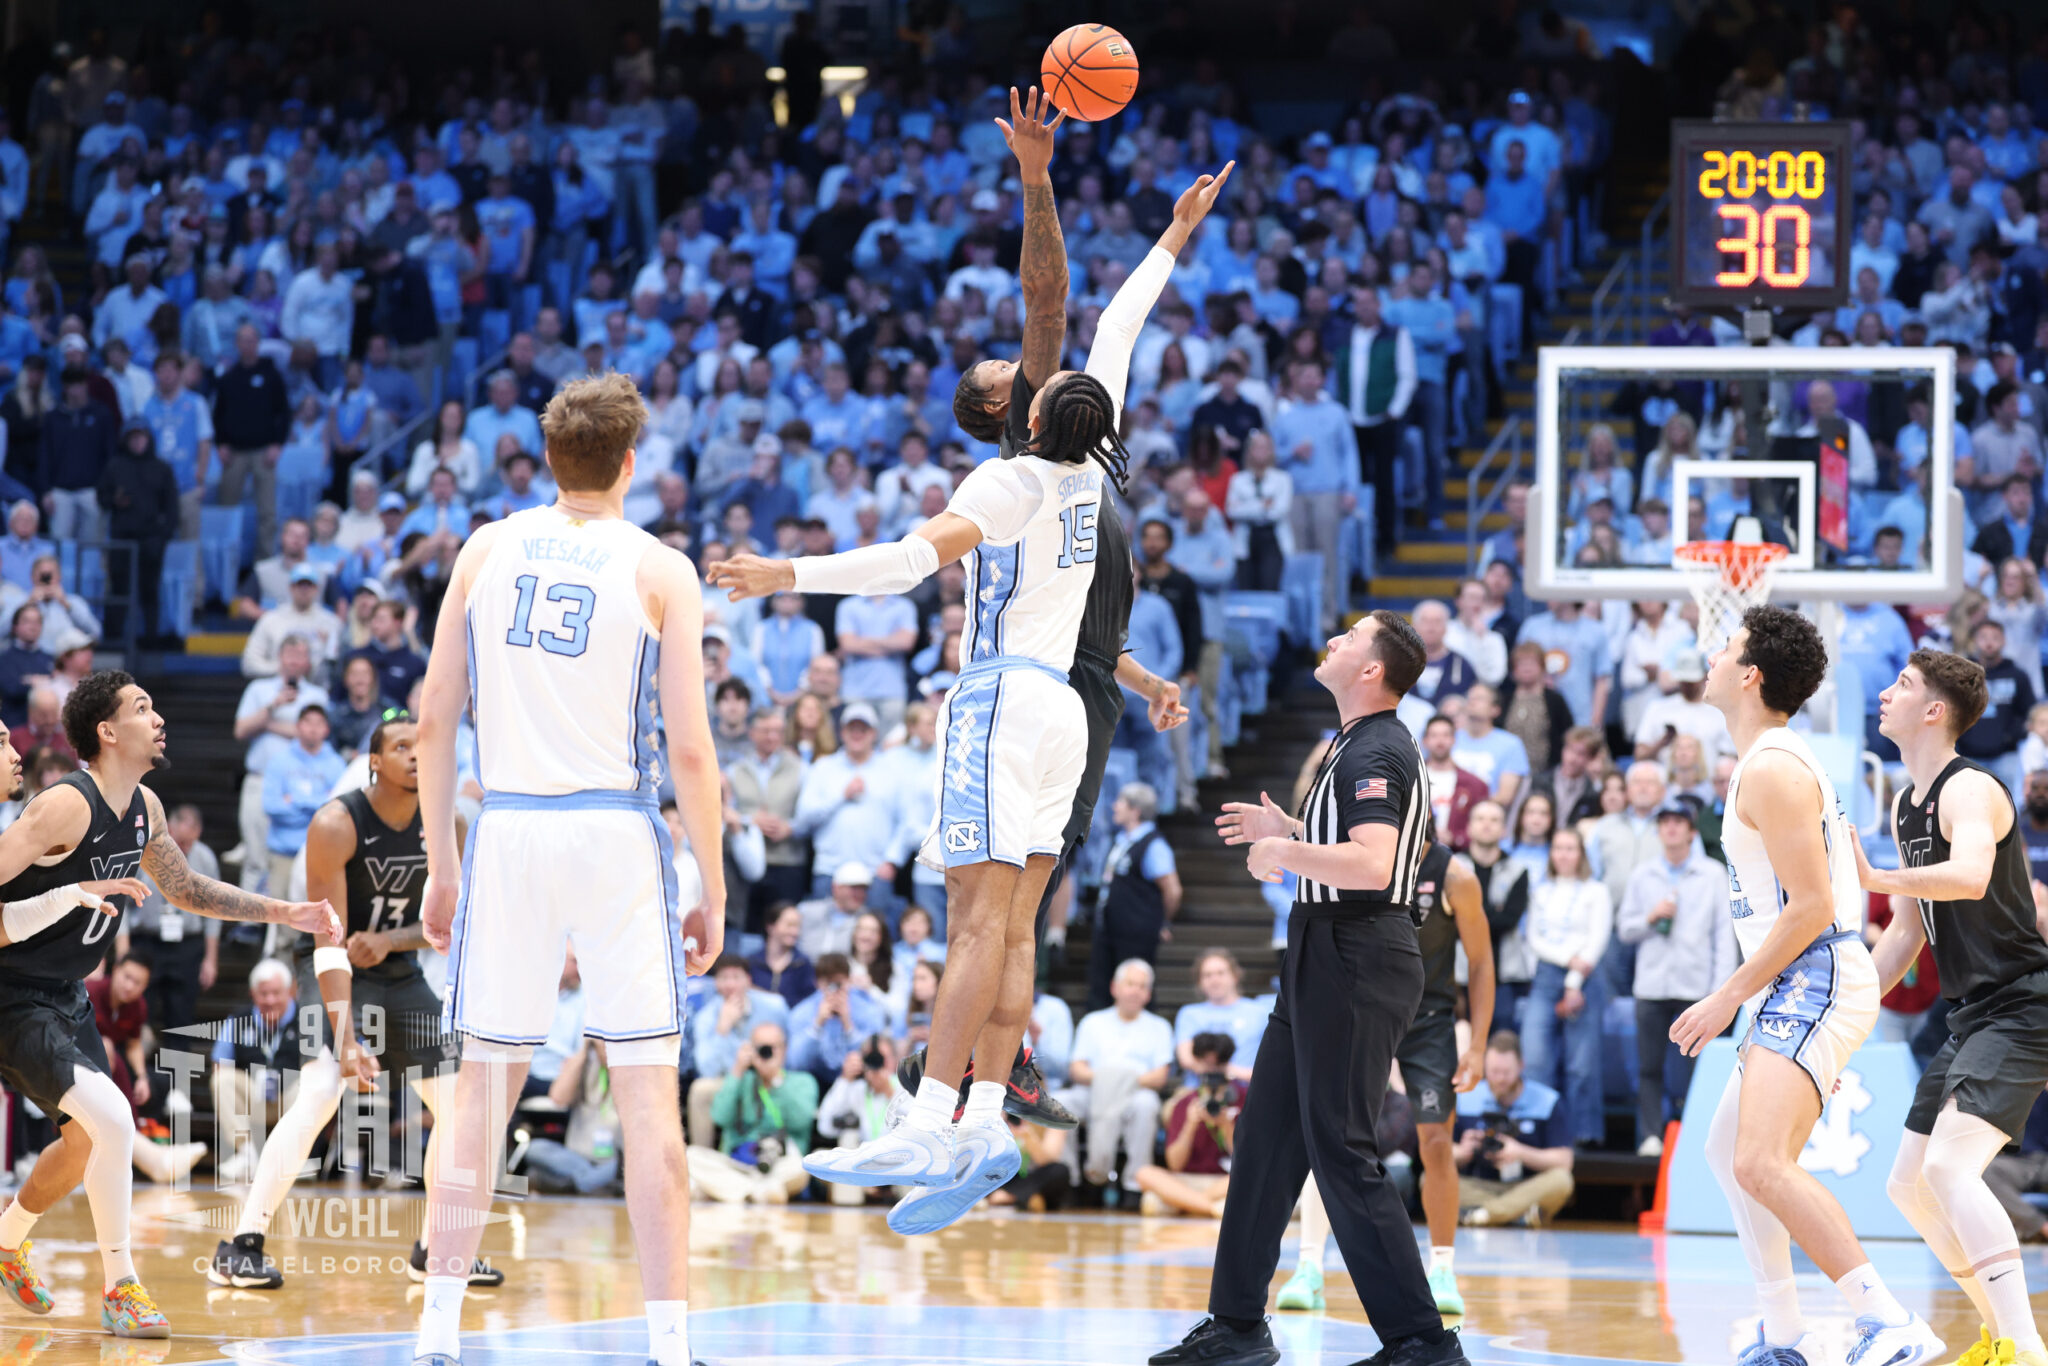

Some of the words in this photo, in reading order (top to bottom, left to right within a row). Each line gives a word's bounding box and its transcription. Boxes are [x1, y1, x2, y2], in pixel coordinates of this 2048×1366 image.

[1699, 151, 1825, 199] 20:00
[1715, 204, 1811, 288] 30
[522, 537, 612, 574] VEESAAR
[1057, 502, 1098, 568] 15
[506, 574, 596, 657] 13
[90, 849, 143, 882] VT
[364, 854, 429, 894] VT
[366, 895, 411, 934] 13
